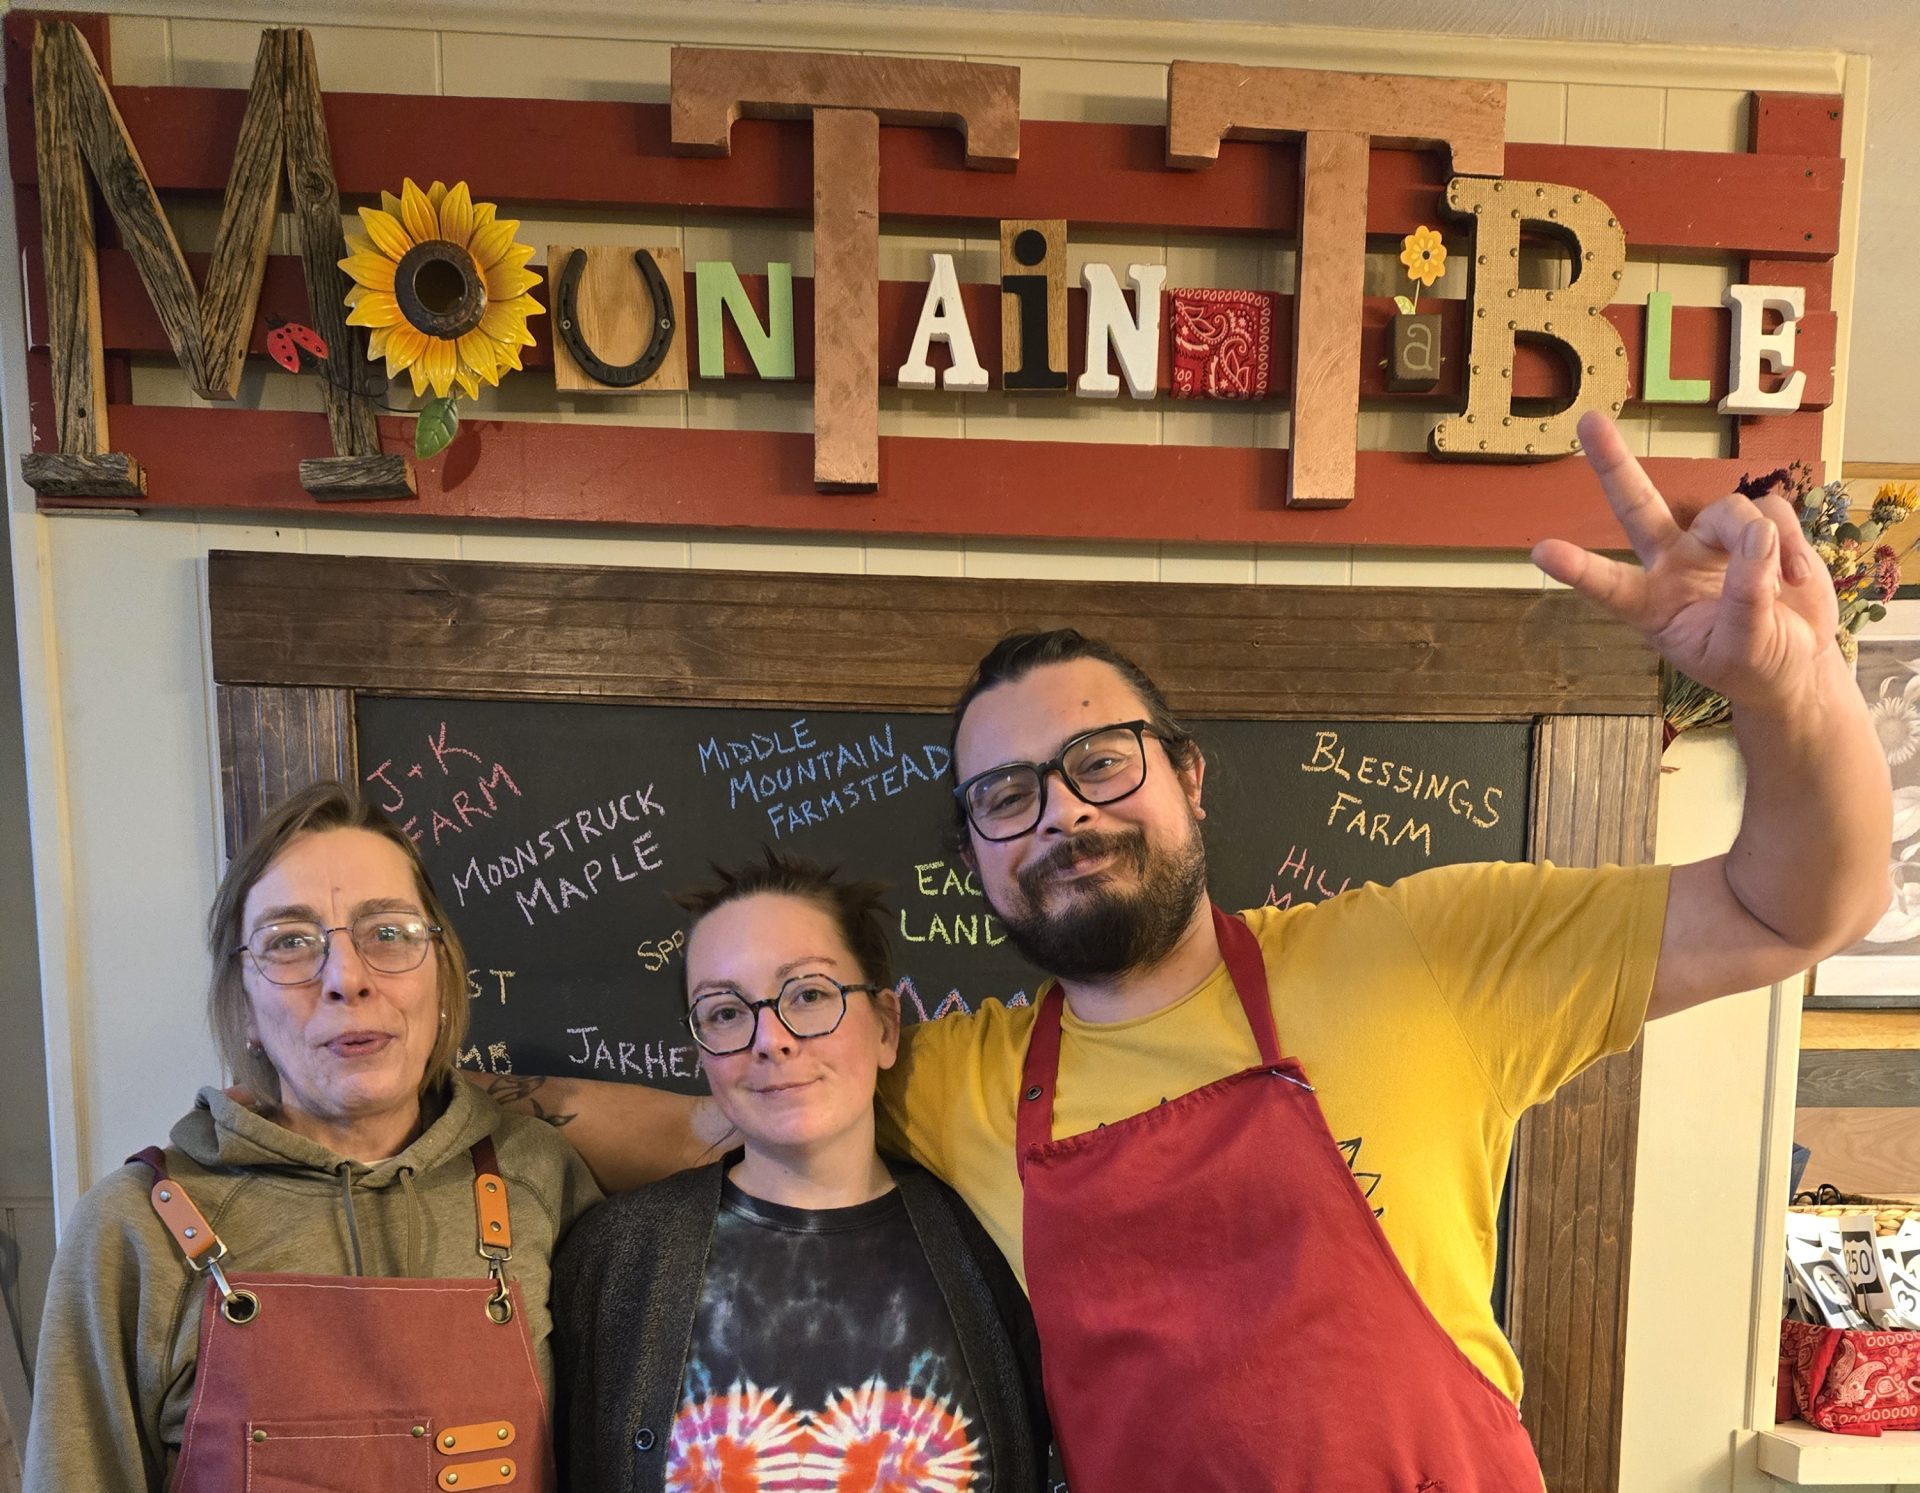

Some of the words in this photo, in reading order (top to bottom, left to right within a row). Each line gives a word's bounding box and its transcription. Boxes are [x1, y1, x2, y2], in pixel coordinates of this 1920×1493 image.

[366, 758, 404, 813] J
[427, 720, 483, 776] K
[697, 717, 817, 775] MIDDLE
[728, 722, 895, 810] MOUNTAIN
[766, 744, 951, 840] FARMSTEAD
[1301, 730, 1503, 829] BLESSINGS
[1326, 791, 1432, 858] FARM
[515, 830, 663, 926] MAPLE
